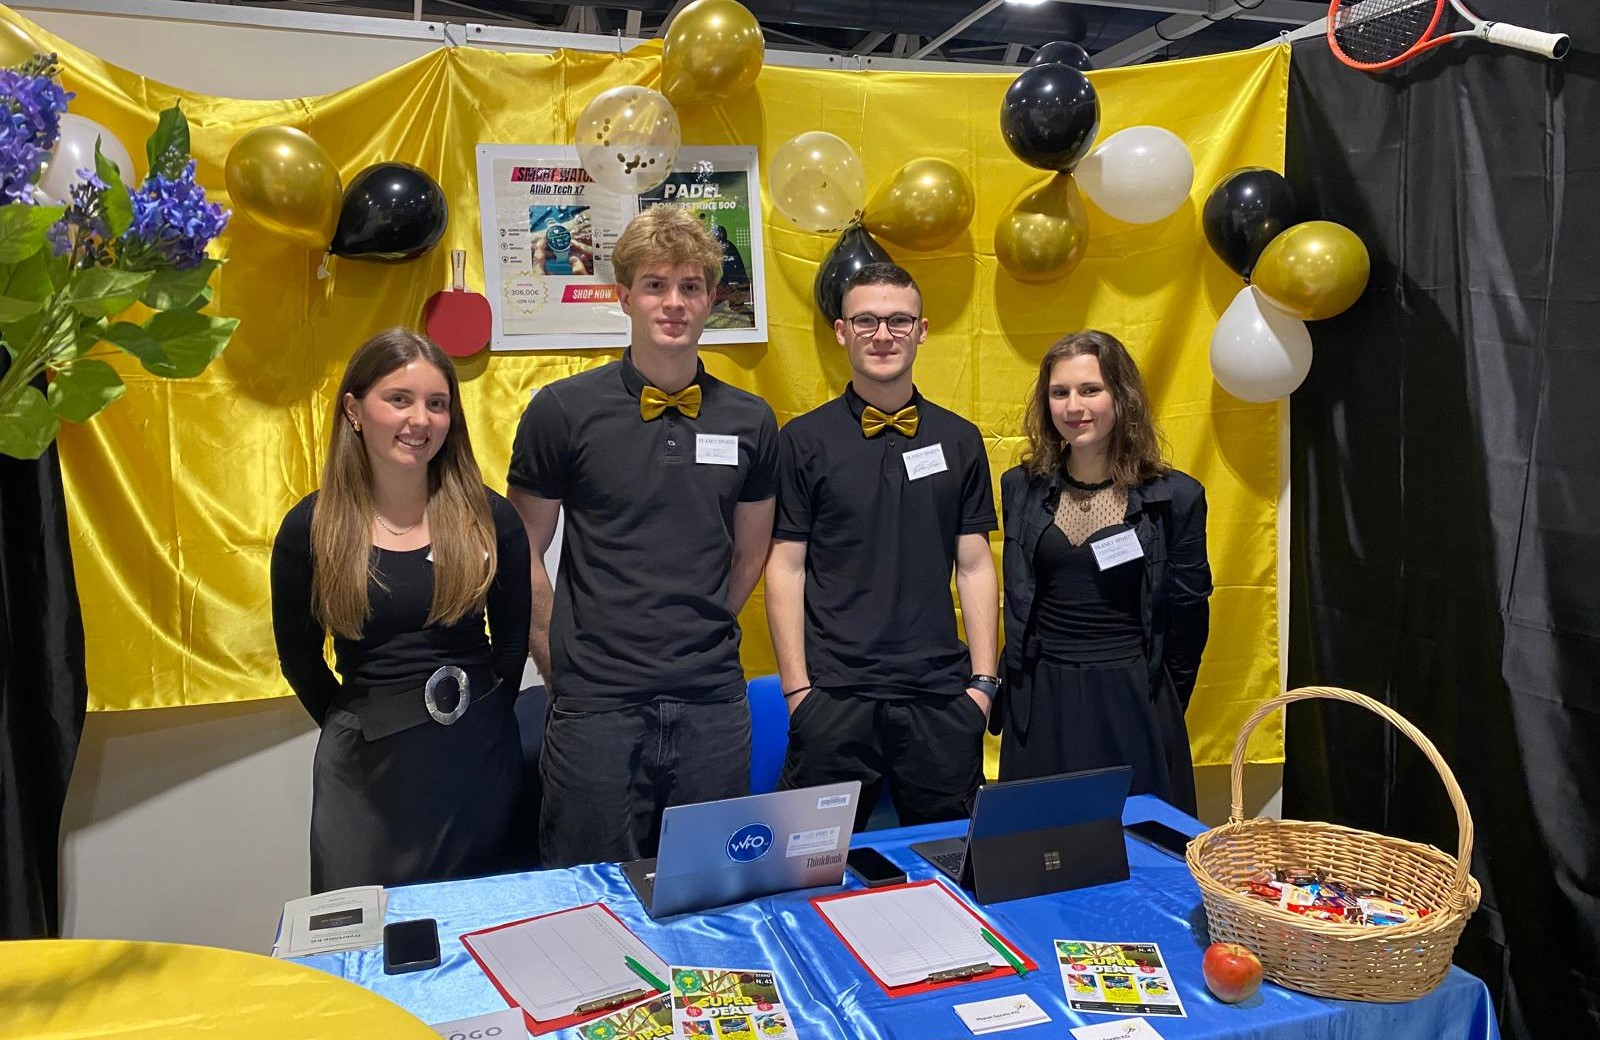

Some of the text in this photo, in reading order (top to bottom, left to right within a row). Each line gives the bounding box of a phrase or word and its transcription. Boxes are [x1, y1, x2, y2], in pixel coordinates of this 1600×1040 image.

[517, 167, 596, 182] SMART WATC
[553, 184, 572, 194] Tech
[574, 185, 585, 195] x7
[664, 183, 722, 199] PADEL
[718, 201, 736, 209] 500
[572, 289, 613, 299] SHOP NOW
[806, 853, 843, 868] ThinkBook
[1084, 958, 1137, 967] SUPER
[699, 996, 754, 1007] SUPER
[710, 1006, 751, 1017] DEAL
[449, 1026, 502, 1040] OGO
